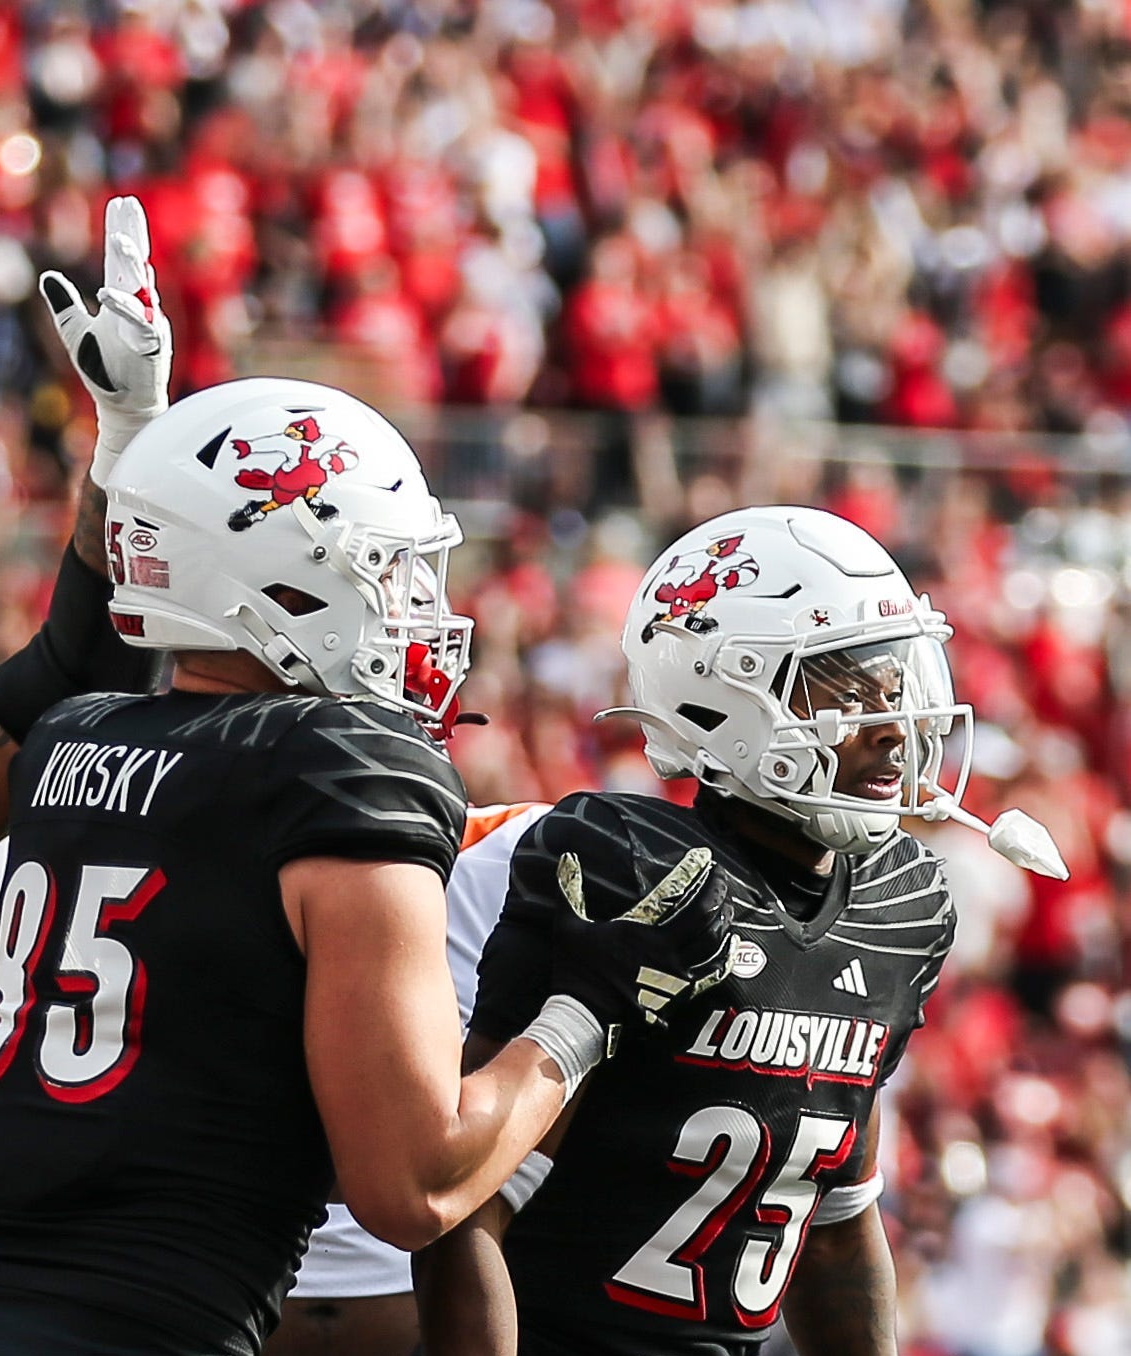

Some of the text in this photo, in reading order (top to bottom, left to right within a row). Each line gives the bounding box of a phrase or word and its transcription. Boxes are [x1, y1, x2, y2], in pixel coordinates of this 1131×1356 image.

[31, 741, 182, 816] KURISKY
[681, 1008, 888, 1085] LOUISVILLE
[607, 1105, 854, 1323] 25
